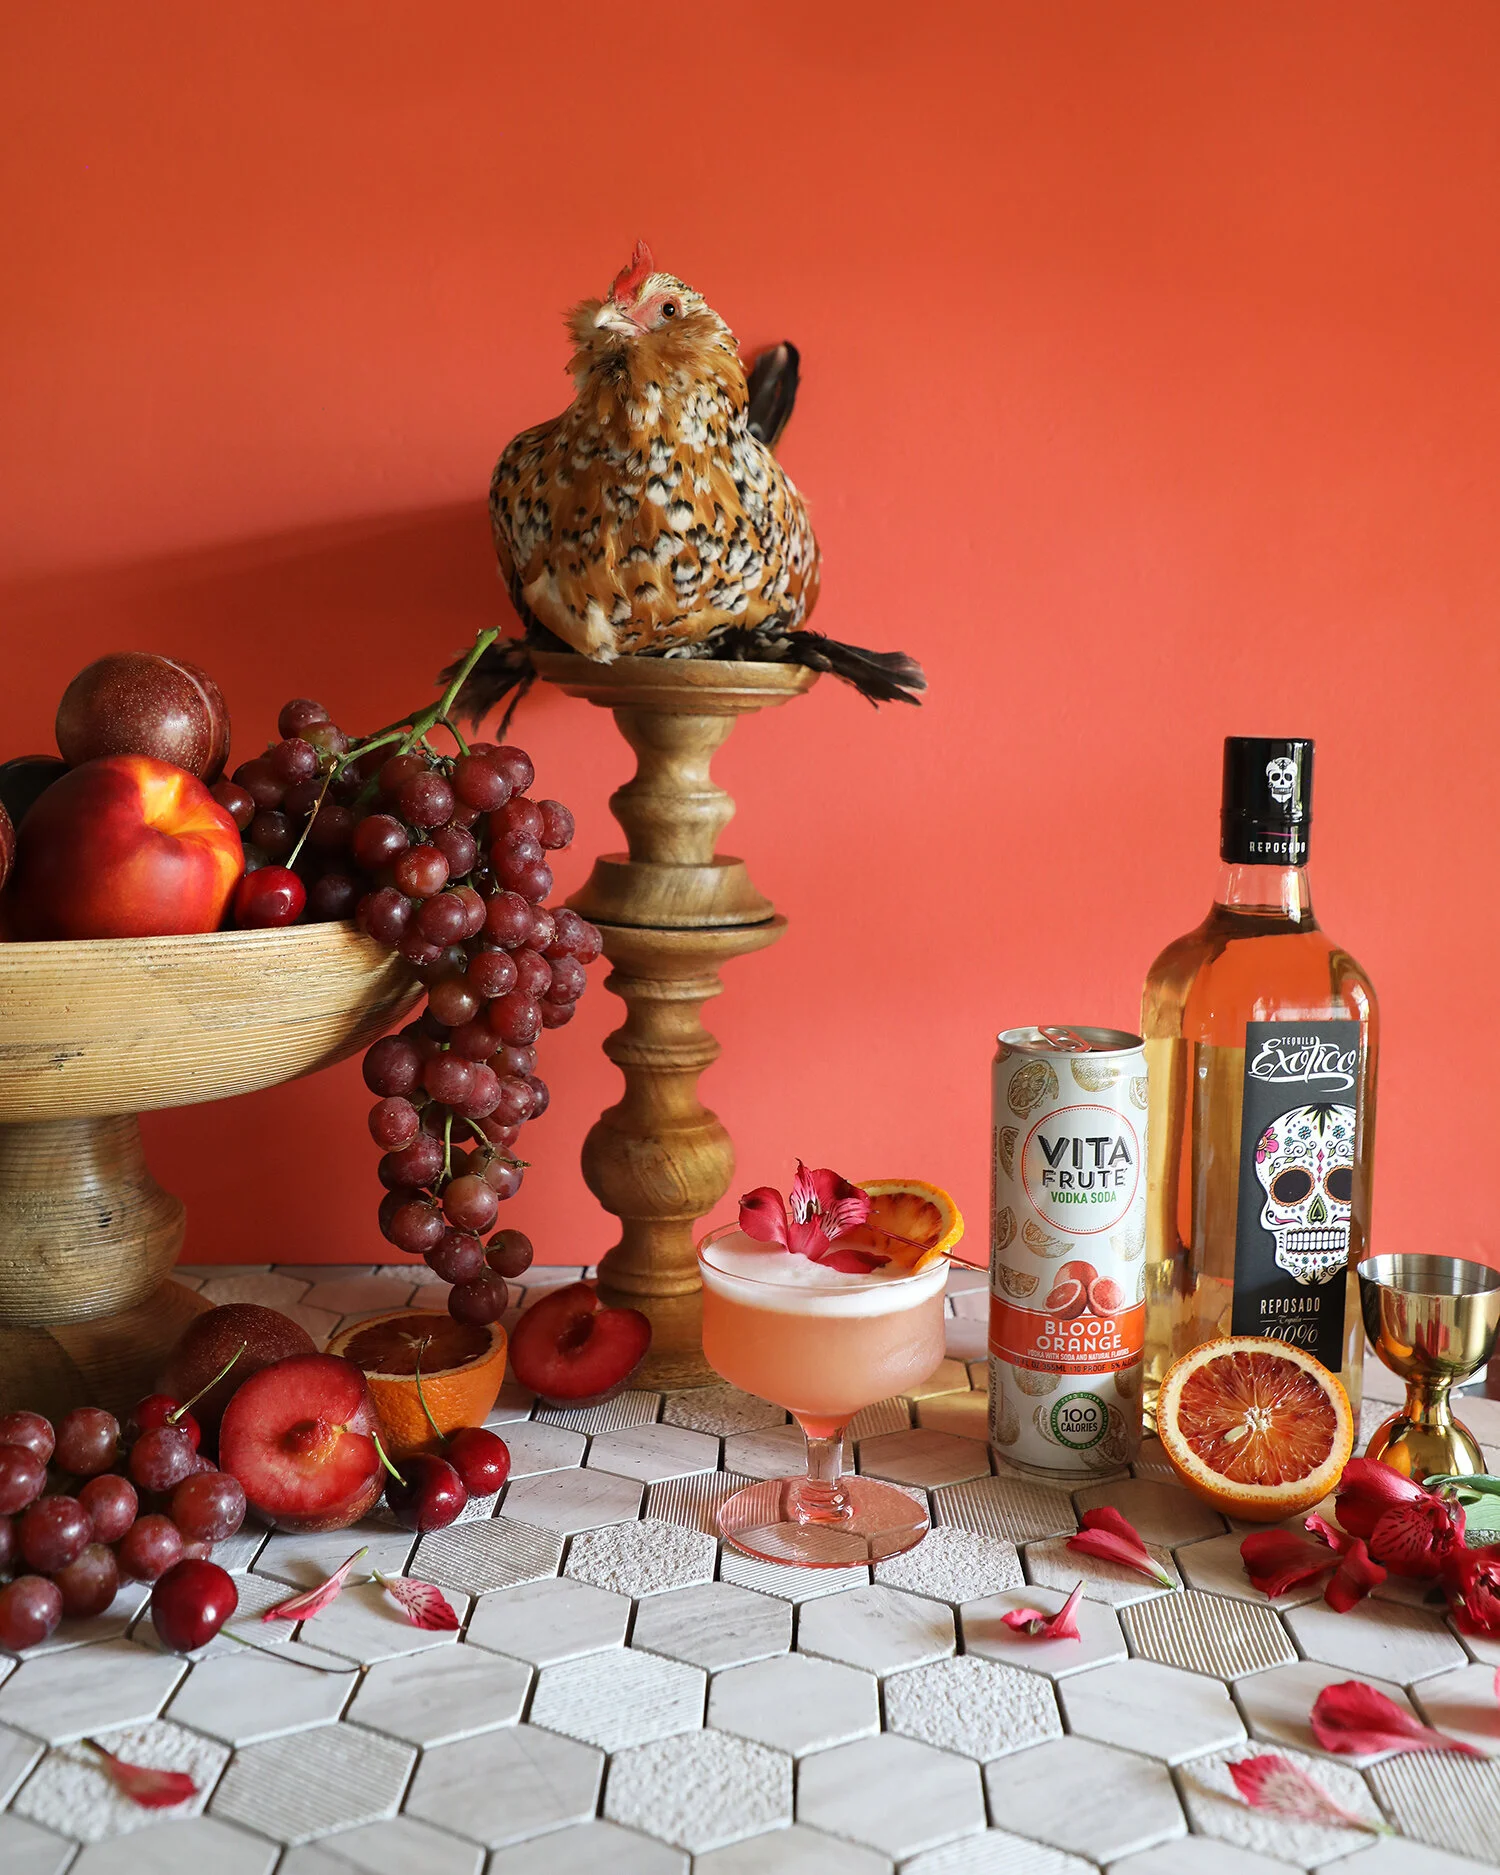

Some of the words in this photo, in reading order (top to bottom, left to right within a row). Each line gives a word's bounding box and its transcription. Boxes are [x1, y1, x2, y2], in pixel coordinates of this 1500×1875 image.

[1249, 841, 1306, 853] REPOSADO
[1281, 1036, 1316, 1046] TEQUILA
[1248, 1036, 1357, 1088] Exotico
[1037, 1135, 1133, 1169] VITA
[1050, 1191, 1088, 1204] VODKA
[1091, 1191, 1117, 1203] SODA
[1260, 1297, 1321, 1315] REPOSADO
[1045, 1320, 1116, 1336] BLOOD
[1036, 1334, 1122, 1352] ORANGE
[1045, 1352, 1060, 1360] WITH
[1061, 1353, 1075, 1361] SODA
[1076, 1353, 1087, 1361] AND
[1088, 1351, 1110, 1361] NATURAL
[1083, 1363, 1106, 1372] PROOF
[1062, 1408, 1097, 1422] 100
[1061, 1422, 1098, 1433] CALORIES
